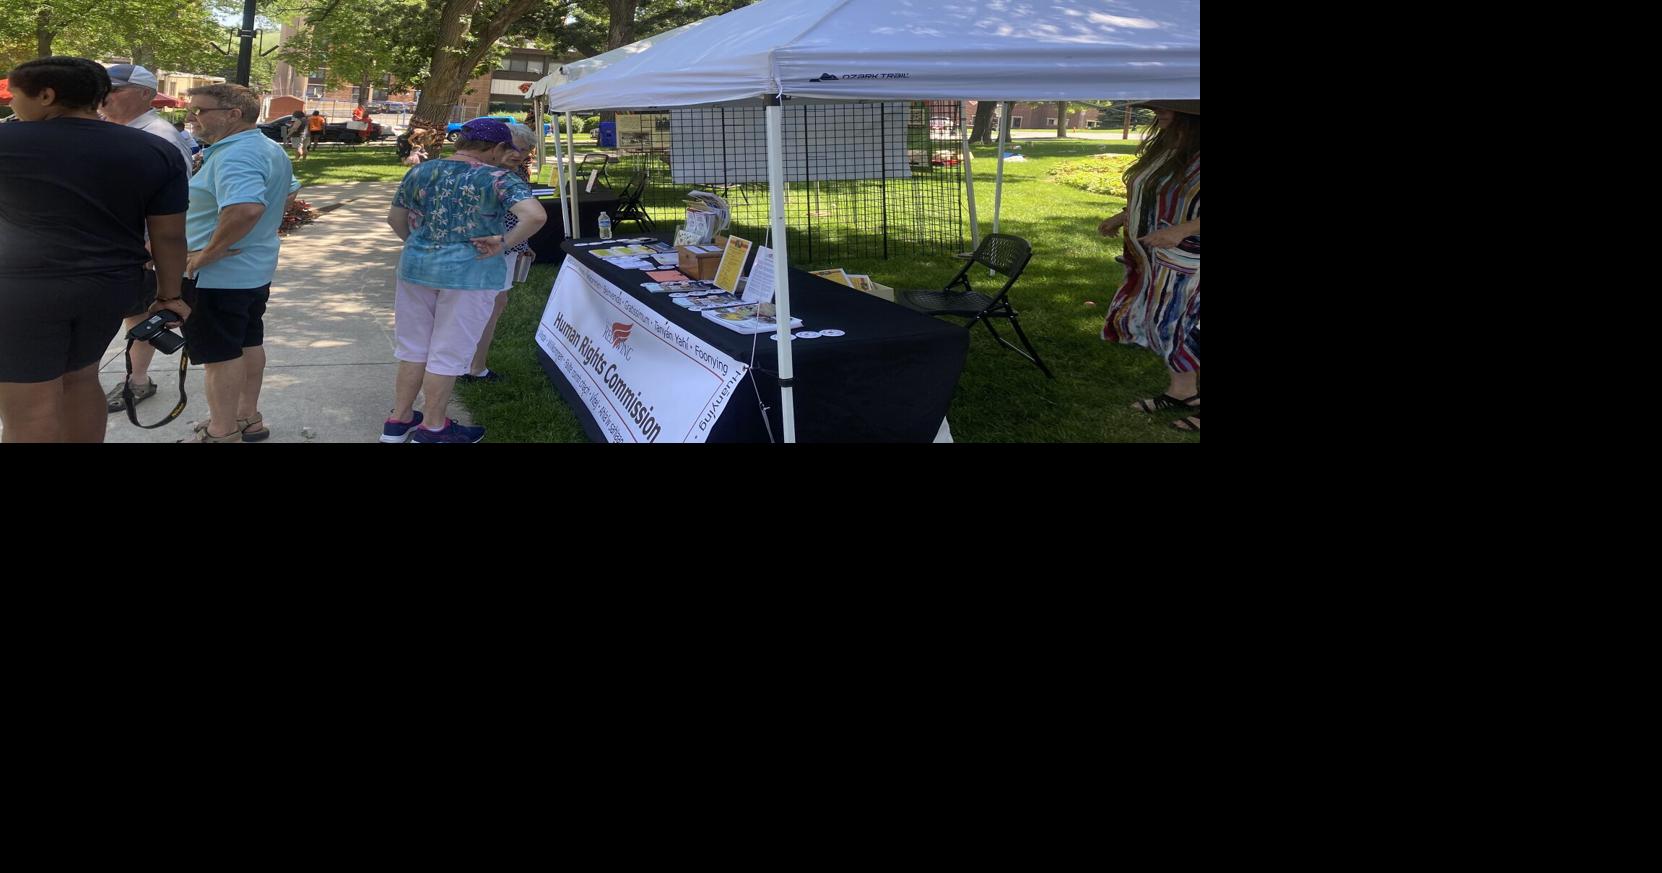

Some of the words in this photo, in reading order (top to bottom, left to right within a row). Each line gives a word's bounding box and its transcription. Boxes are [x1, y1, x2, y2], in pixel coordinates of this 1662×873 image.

[553, 311, 580, 348] Human
[578, 336, 607, 376] Rights
[603, 363, 661, 444] Commission
[694, 345, 729, 377] Foonying
